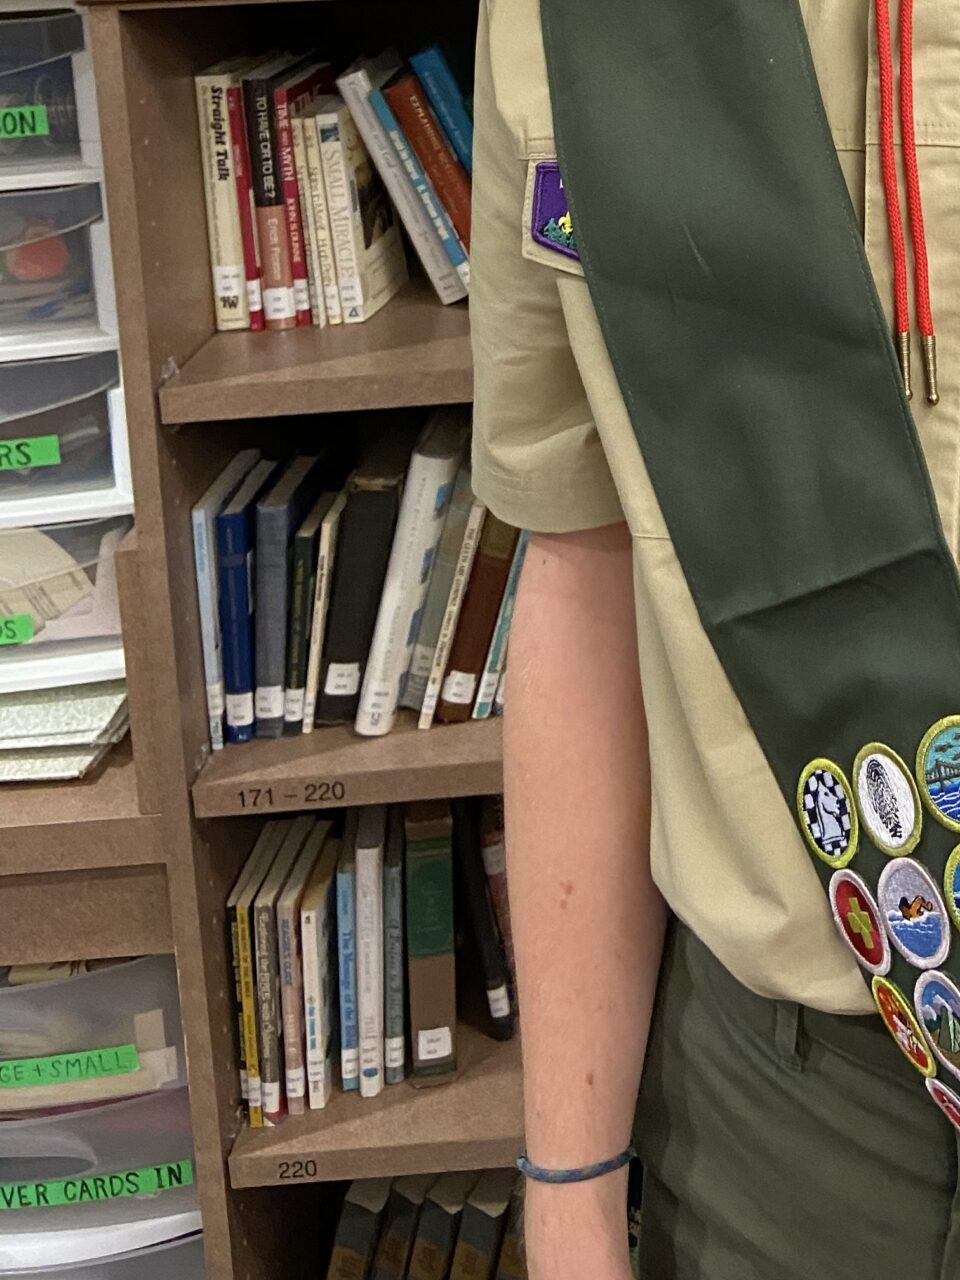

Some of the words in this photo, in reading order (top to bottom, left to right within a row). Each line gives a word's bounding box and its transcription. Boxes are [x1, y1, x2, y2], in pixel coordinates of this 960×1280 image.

[210, 85, 227, 147] Straight
[256, 96, 268, 110] TO
[2, 111, 37, 135] ON
[257, 112, 271, 142] HAVE
[215, 148, 229, 181] Talk
[259, 143, 273, 160] OR
[279, 147, 293, 181] MYTH
[261, 160, 274, 175] TO
[324, 150, 346, 204] SMALL
[267, 218, 281, 246] Erich
[237, 787, 274, 809] 171
[304, 781, 346, 803] 220
[50, 1050, 130, 1079] SMALL
[278, 1159, 318, 1179] 220
[1, 1184, 50, 1208] VER
[63, 1171, 141, 1203] CARDS
[155, 1162, 184, 1188] IN
